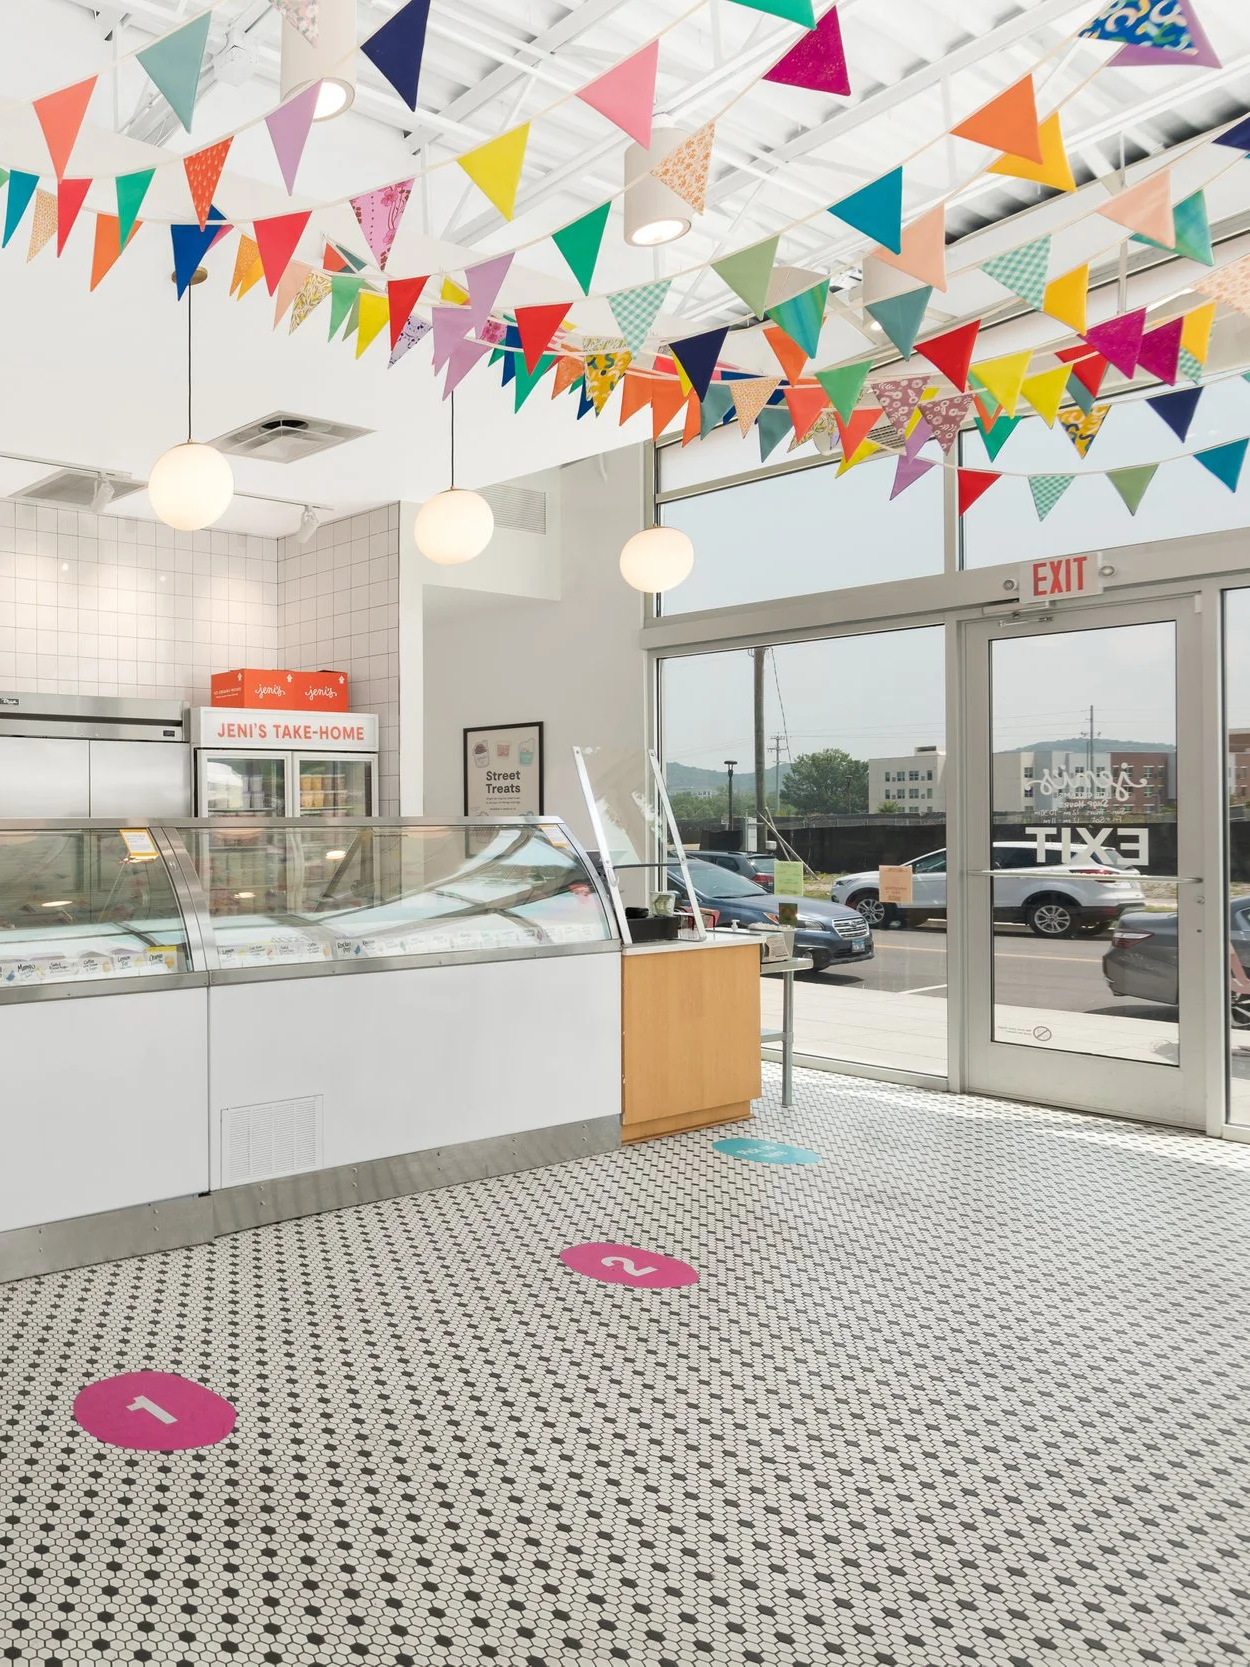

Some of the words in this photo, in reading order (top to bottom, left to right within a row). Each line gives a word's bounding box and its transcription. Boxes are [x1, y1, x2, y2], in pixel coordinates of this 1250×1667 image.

[1033, 556, 1087, 596] EXIT
[254, 683, 286, 699] jeni's
[304, 686, 338, 701] jeni's
[217, 722, 267, 739] JENI'S
[273, 724, 364, 740] TAKE-HOME
[486, 770, 521, 782] Street
[486, 784, 521, 794] Treats
[601, 1256, 659, 1277] 2
[126, 1395, 178, 1424] 1
